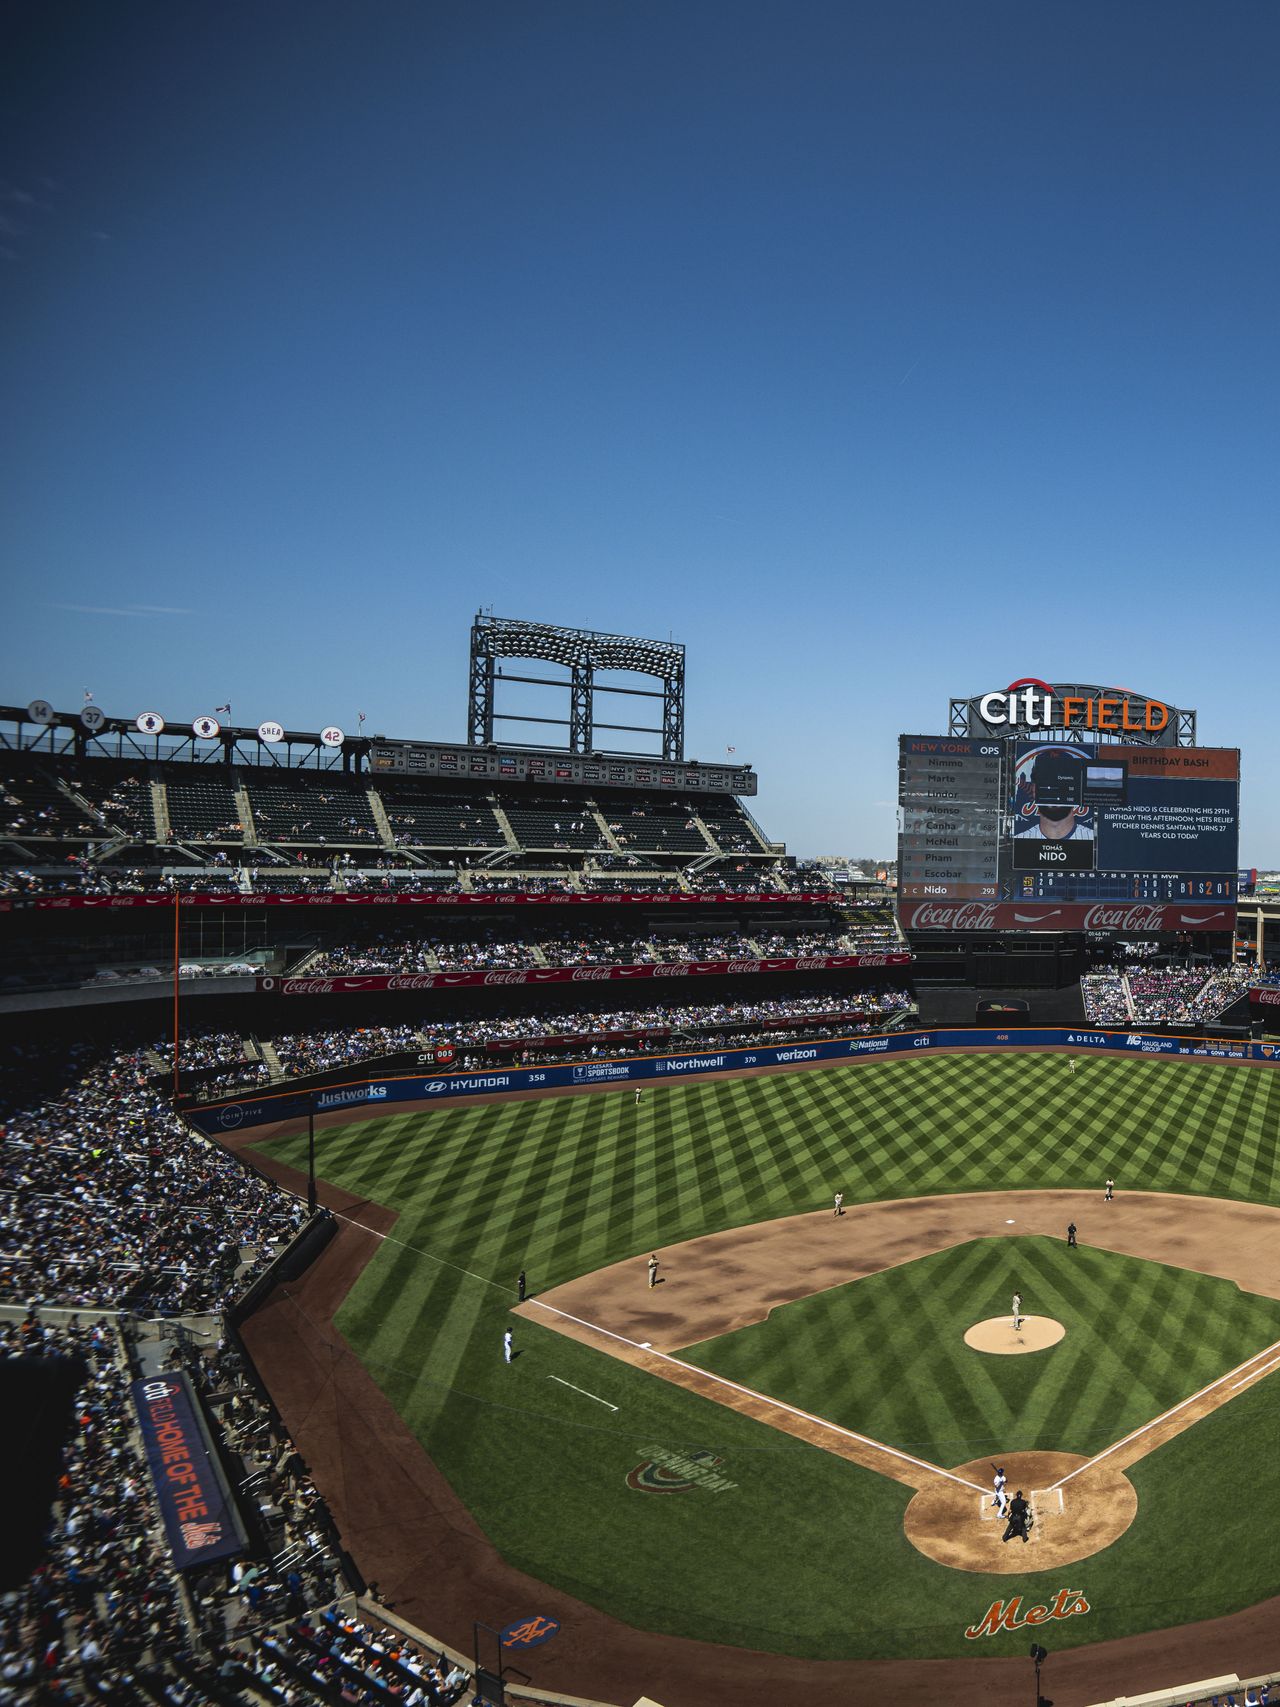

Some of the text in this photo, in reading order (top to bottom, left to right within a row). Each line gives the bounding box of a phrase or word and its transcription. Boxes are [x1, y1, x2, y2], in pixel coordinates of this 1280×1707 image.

[980, 678, 1169, 731] citi FIELD
[35, 706, 47, 718] 14
[86, 711, 101, 724] 37
[261, 726, 281, 736] SHEA
[324, 730, 340, 742] 42
[377, 750, 395, 758] HOU
[911, 743, 972, 754] NEW YORK
[979, 746, 1000, 756] OPS
[409, 752, 426, 760] SEA
[440, 754, 457, 762] STL
[472, 756, 485, 764] MIL
[1132, 755, 1209, 768] BIRTHDAY BASH
[557, 762, 571, 770] LAD
[928, 759, 963, 768] Nimmo
[927, 774, 955, 783] Marte
[927, 789, 958, 799] Lindor
[926, 806, 960, 815] Alonso
[1133, 805, 1149, 813] NIDO
[1158, 806, 1201, 815] CELEBRATING
[1214, 808, 1229, 816] 29TH
[1104, 813, 1136, 821] BIRTHDAY
[1137, 814, 1151, 822] THIS
[1213, 816, 1234, 824] RELIEF
[926, 821, 956, 830] Canha
[1111, 822, 1139, 830] PITCHER
[1140, 823, 1164, 831] DENNIS
[1165, 824, 1196, 832] SANTANA
[926, 837, 959, 846] McNeil
[1140, 832, 1161, 840] YEARS
[1177, 833, 1199, 841] TODAY
[1041, 842, 1063, 851] TOMÁS
[925, 853, 952, 862] Pham
[1038, 851, 1067, 862] NIDO
[924, 869, 962, 878] Escobar
[924, 885, 995, 895] Nido .293
[1180, 881, 1229, 895] B 1 S 2 1
[911, 902, 1001, 930] Coca-Cola
[1083, 904, 1167, 930] Coca-Cola
[795, 957, 827, 970] Coca-Cola
[858, 954, 888, 966] Coca-Cola
[653, 964, 690, 977] Coca-Cola
[727, 961, 761, 974] Coca-Cola
[484, 969, 529, 985] Coca-Cola
[572, 966, 613, 981] Coca-Cola
[283, 978, 336, 995] Coca-Cola
[387, 974, 437, 990] Coca-Cola
[858, 1038, 889, 1050] National
[914, 1034, 930, 1046] citi
[1076, 1035, 1106, 1044] DELTA
[1141, 1040, 1173, 1050] HAUGLAND
[776, 1047, 817, 1062] verizon
[1179, 1047, 1190, 1055] 380
[1193, 1048, 1208, 1056] GOYA
[418, 1053, 434, 1061] citi
[744, 1055, 757, 1065] 370
[588, 1063, 613, 1072] CAESARS
[666, 1055, 725, 1071] Northwell
[528, 1073, 546, 1082] 358
[588, 1066, 630, 1078] SPORTSBOOK
[450, 1076, 510, 1090] HYUNDAI
[317, 1084, 386, 1106] Justworks
[142, 1381, 181, 1402] citi
[147, 1397, 178, 1424] FIELD
[153, 1422, 191, 1465] HOME
[165, 1462, 198, 1485] OF
[174, 1486, 208, 1522] THE
[965, 1588, 1091, 1640] Mets
